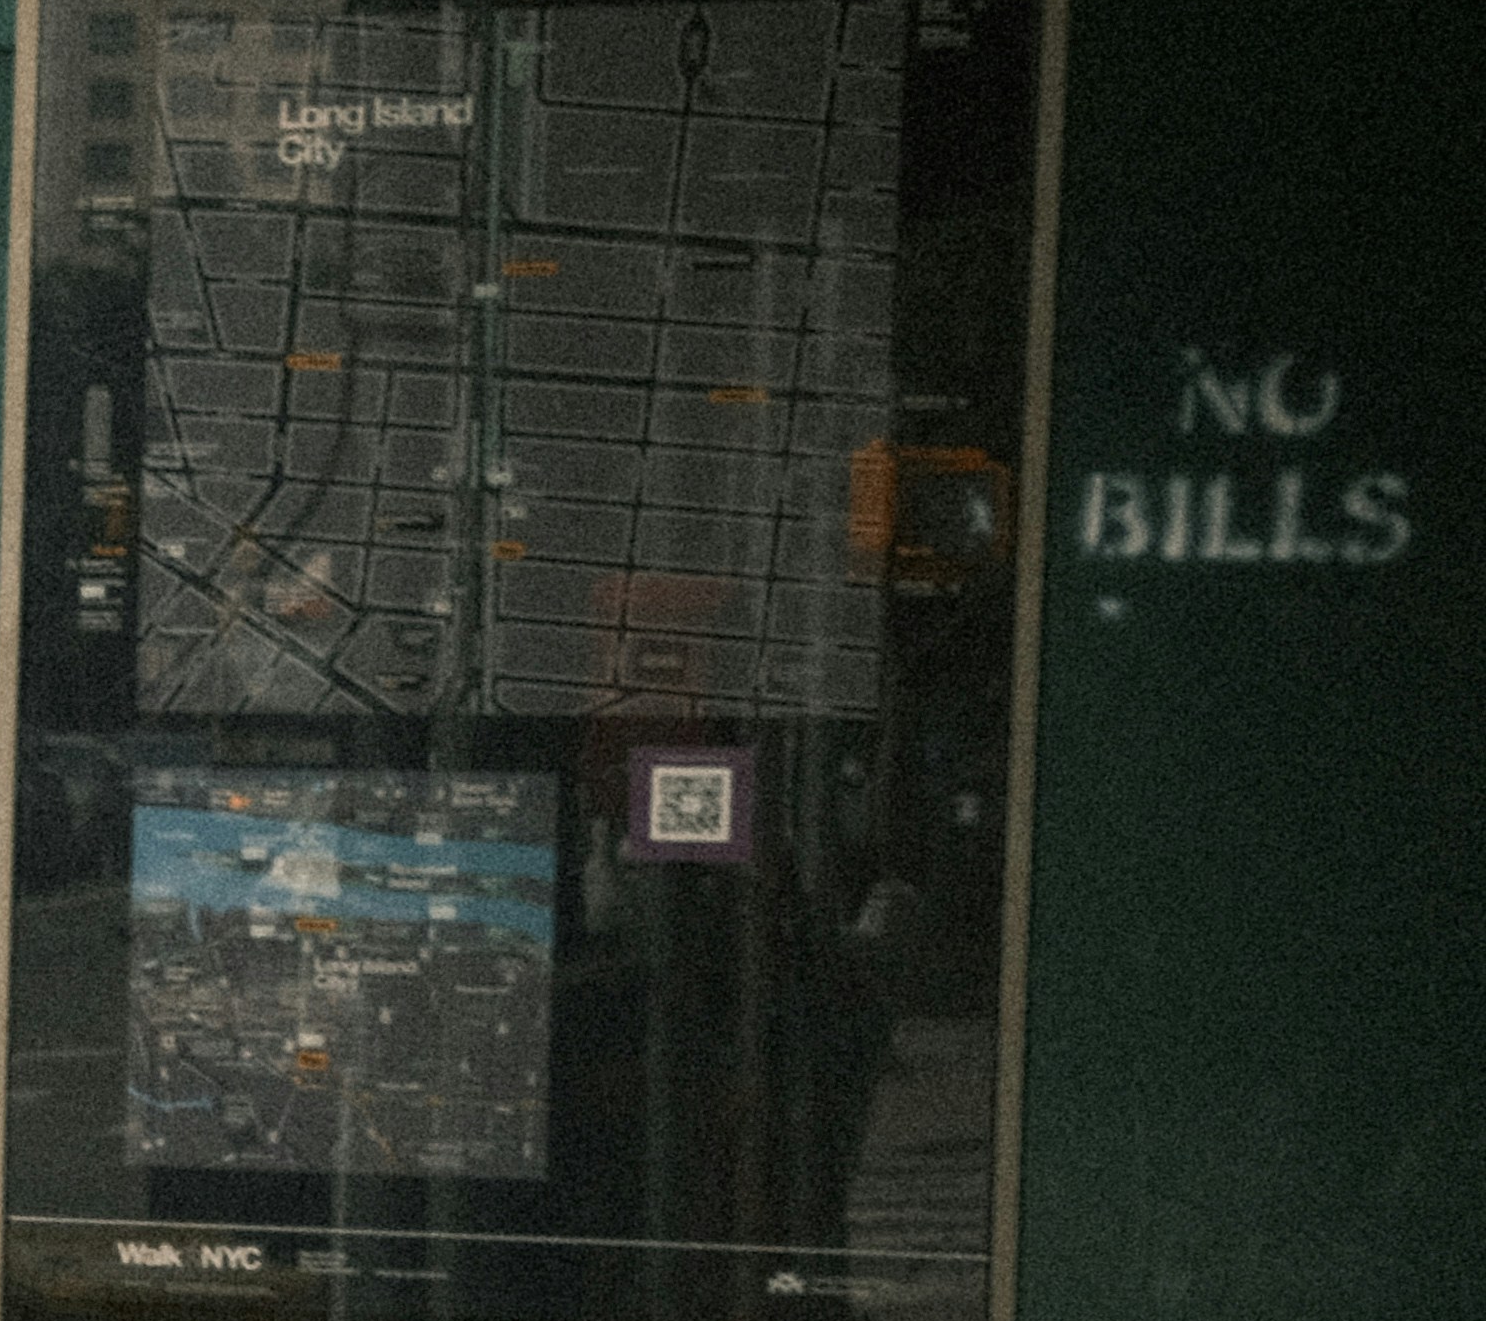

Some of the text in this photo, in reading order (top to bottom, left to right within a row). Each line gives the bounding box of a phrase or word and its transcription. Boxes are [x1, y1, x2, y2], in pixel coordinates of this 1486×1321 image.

[279, 95, 474, 133] Long Island
[278, 134, 343, 170] City
[1178, 347, 1338, 435] NO
[1080, 471, 1412, 563] BILLS
[117, 1241, 262, 1271] Walk NYC
